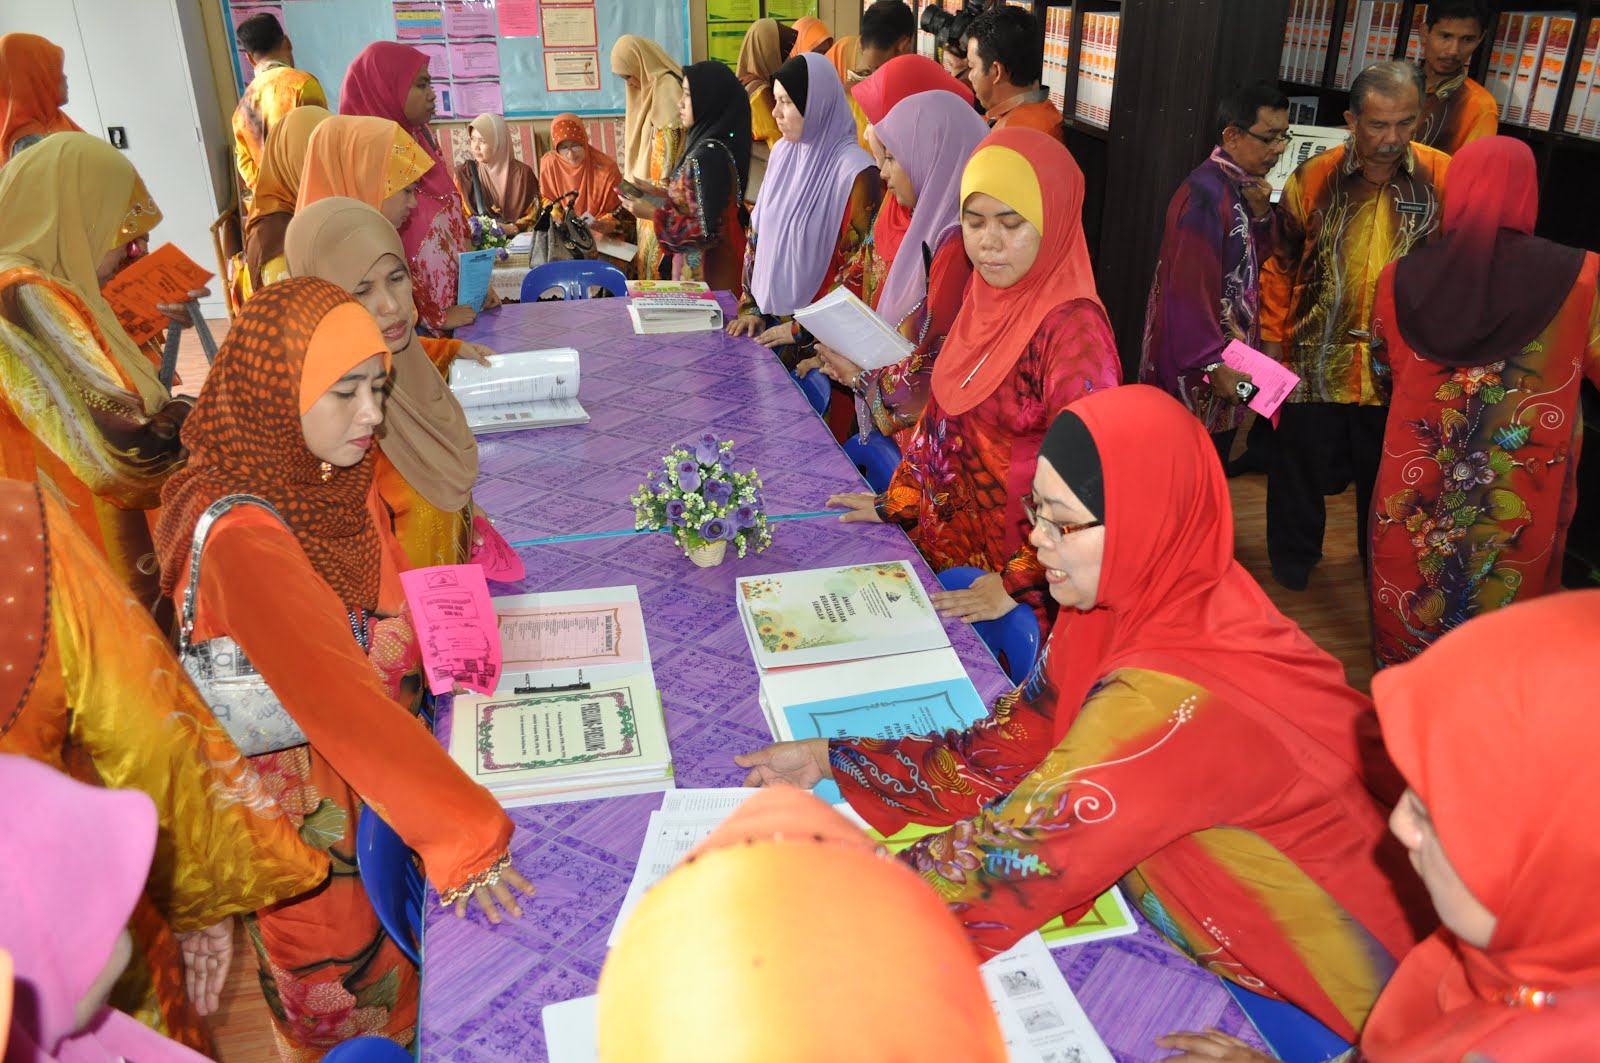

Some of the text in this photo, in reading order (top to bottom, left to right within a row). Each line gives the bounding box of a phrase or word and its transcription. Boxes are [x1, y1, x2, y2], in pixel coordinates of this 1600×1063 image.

[811, 600, 826, 620] SEKOLAH
[819, 595, 838, 623] BERASASKAN
[829, 592, 849, 623] PENTAKSIRAN
[841, 596, 857, 616] ANALISIS
